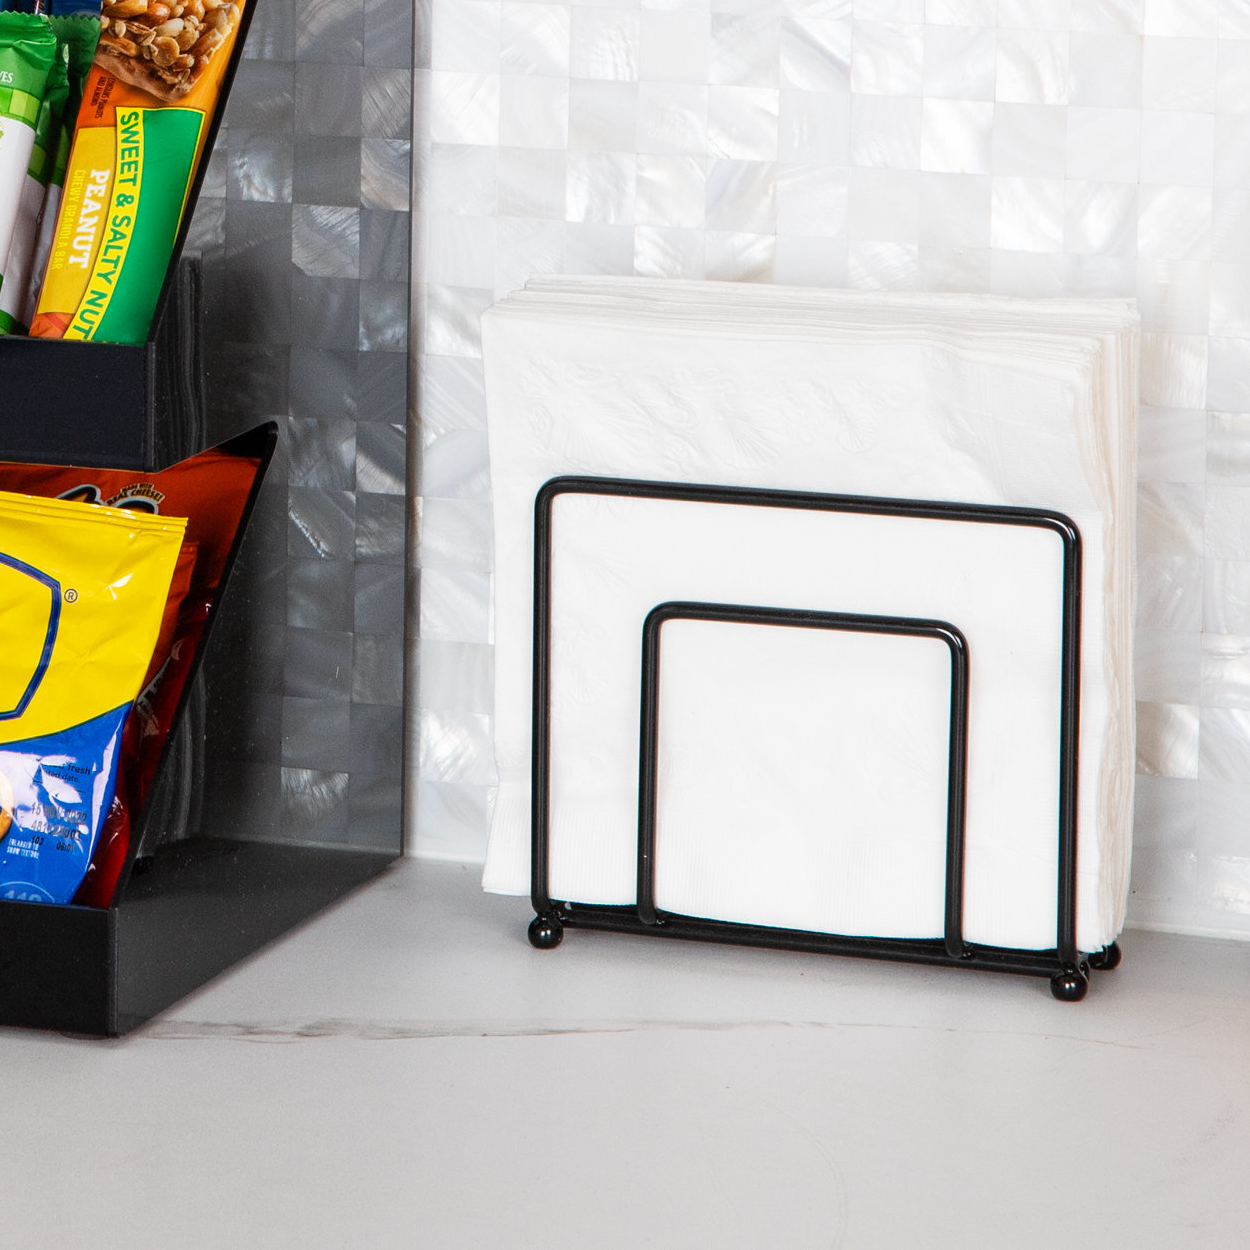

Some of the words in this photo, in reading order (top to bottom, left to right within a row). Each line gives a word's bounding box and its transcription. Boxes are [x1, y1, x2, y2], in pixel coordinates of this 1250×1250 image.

[118, 111, 140, 187] SWEET
[70, 169, 87, 202] CHEWY
[115, 192, 135, 208] &
[57, 204, 77, 248] GRANOLA
[68, 169, 110, 268] PEANUT
[52, 251, 66, 270] BAR
[96, 215, 131, 285] SALTY
[72, 289, 108, 340] NUT
[69, 763, 90, 776] fresh
[6, 846, 20, 855] SHOW
